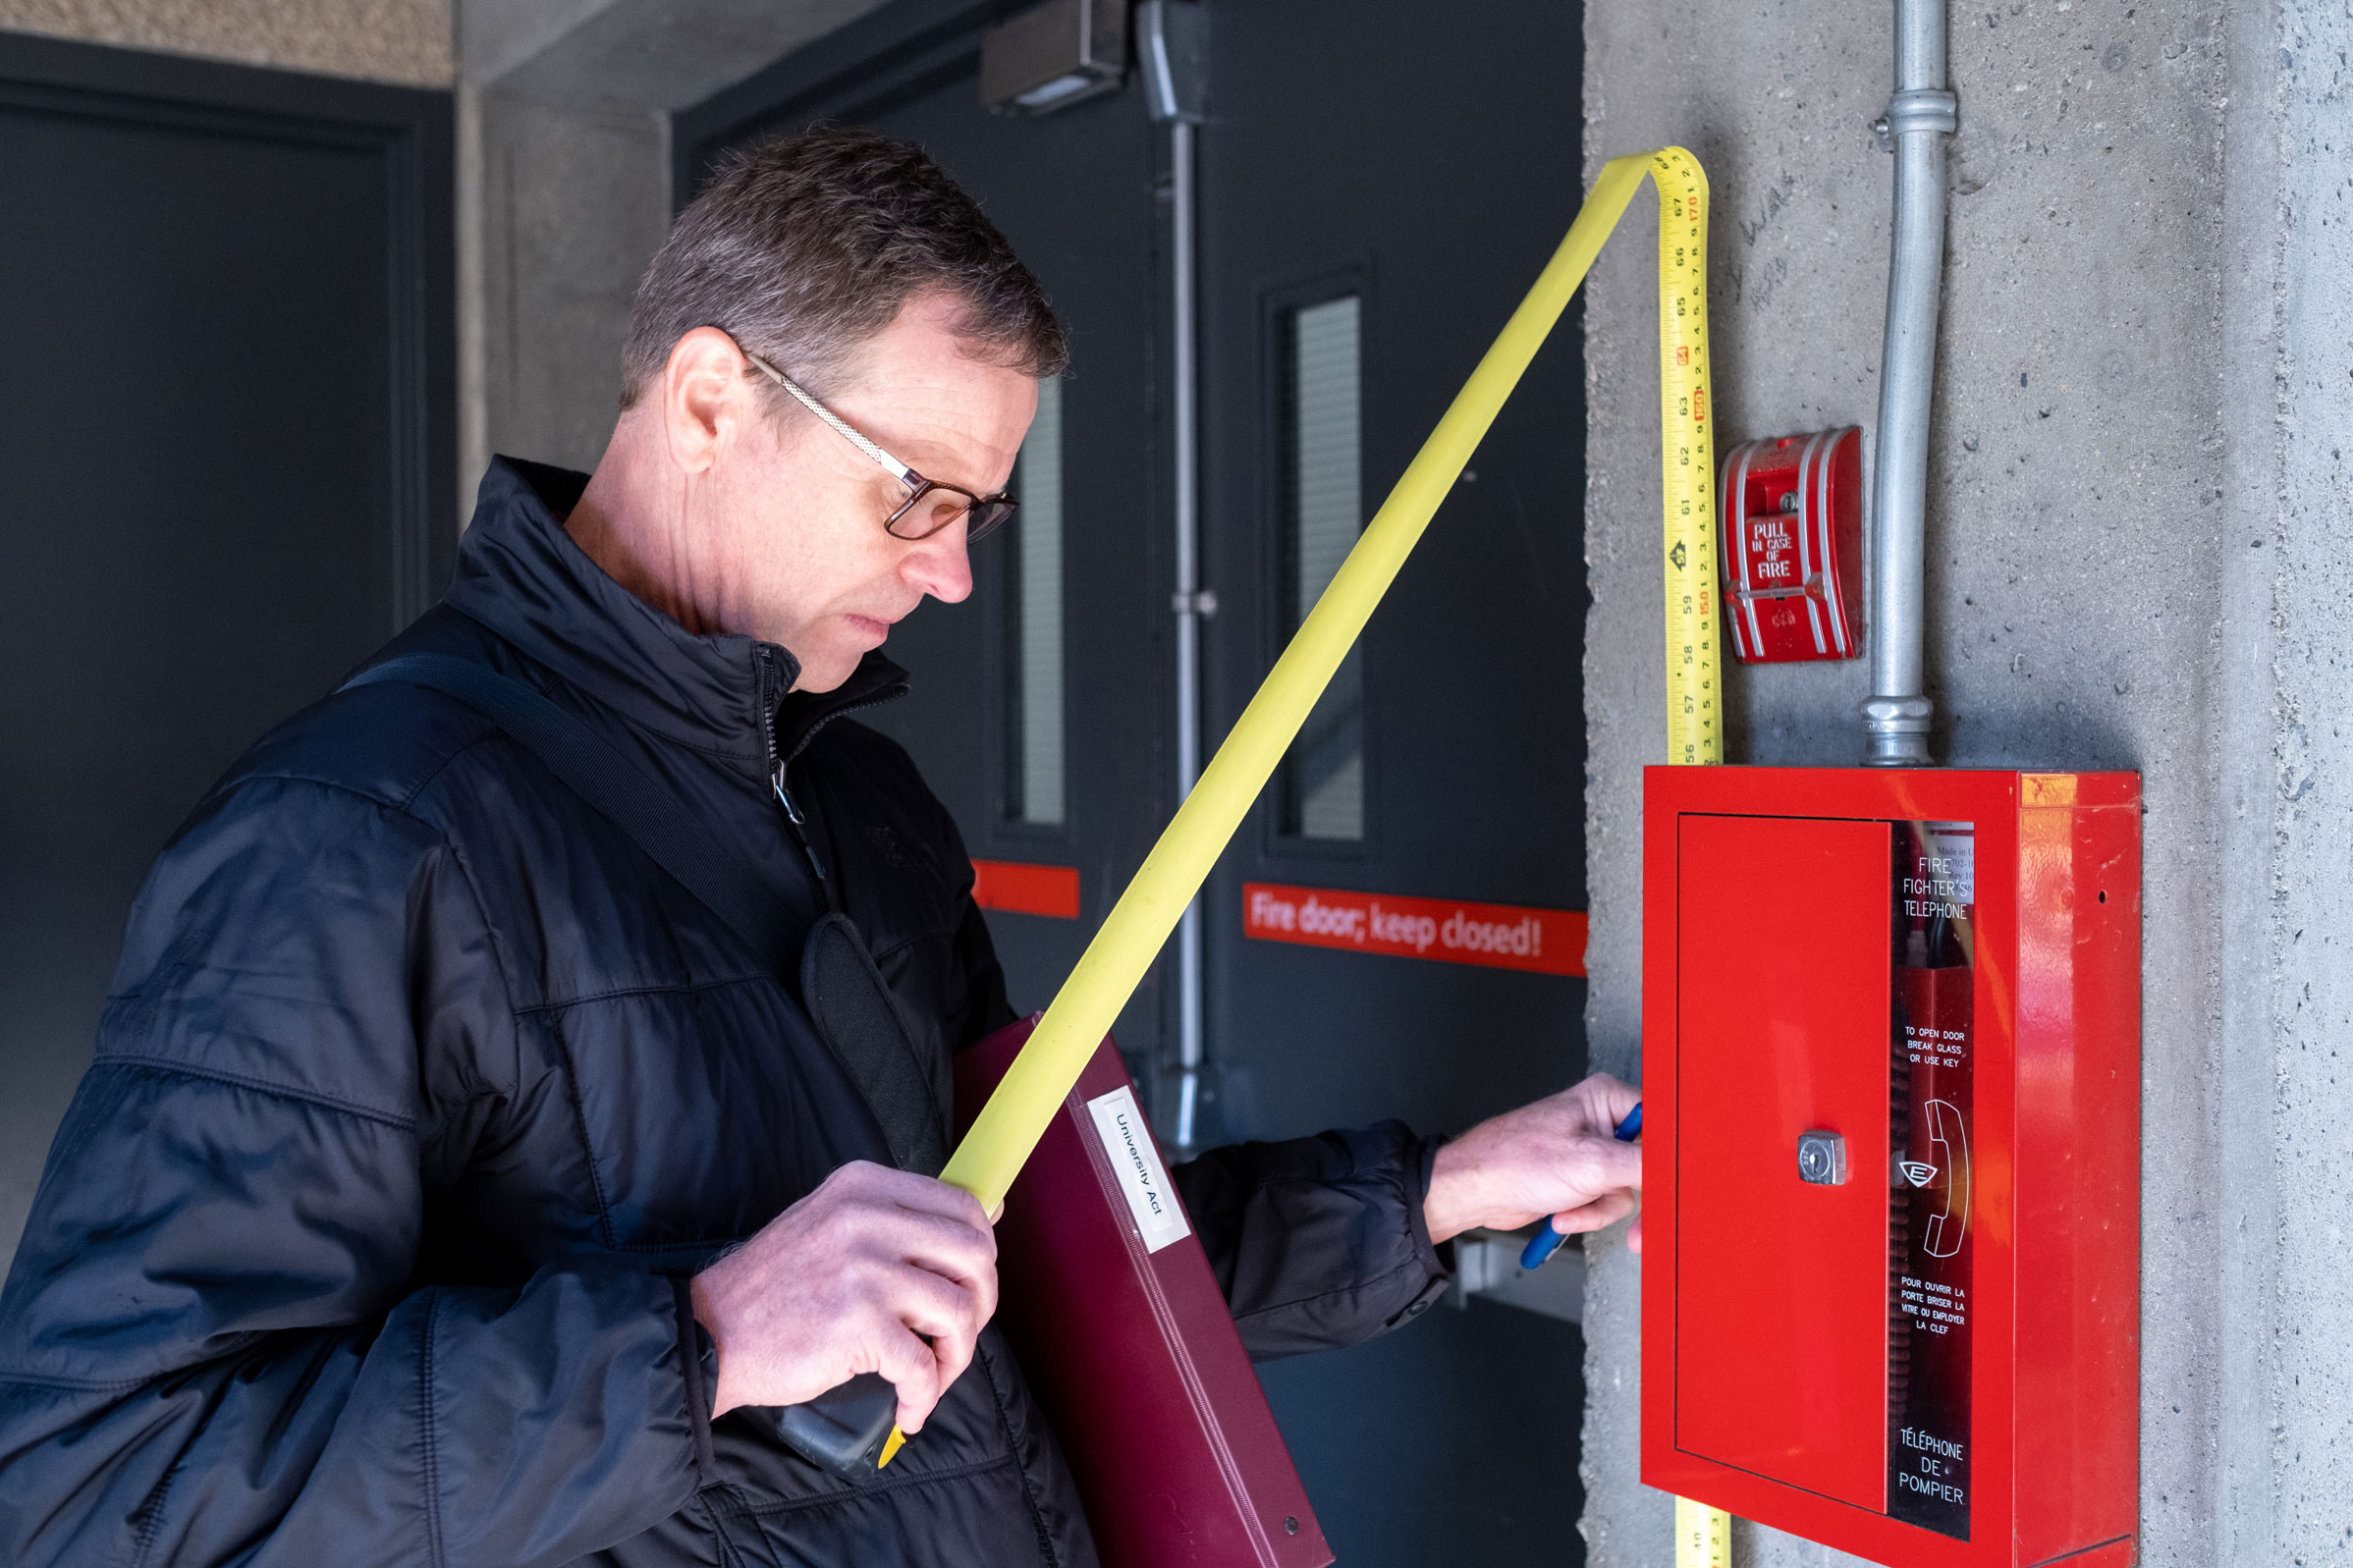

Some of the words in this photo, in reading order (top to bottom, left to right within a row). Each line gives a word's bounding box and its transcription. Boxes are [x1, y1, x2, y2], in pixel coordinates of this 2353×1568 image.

[1673, 198, 1682, 216] 67
[1688, 196, 1698, 222] 170
[1675, 247, 1684, 267] 66
[1677, 297, 1685, 316] 65
[1679, 397, 1688, 416] 63
[1681, 447, 1689, 465] 62
[1681, 500, 1689, 514] 61
[1754, 521, 1787, 540] PULL
[1752, 540, 1763, 552] IN
[1767, 537, 1792, 550] CASE
[1766, 550, 1779, 562] OF
[1701, 563, 1707, 571] 2
[1758, 560, 1790, 579] FIRE
[1683, 596, 1691, 615] 59
[1700, 591, 1709, 615] 150
[1702, 622, 1709, 630] 9
[1684, 645, 1693, 664] 58
[1703, 661, 1710, 670] 7
[1703, 680, 1710, 689] 6
[1685, 695, 1693, 713] 57
[1703, 700, 1711, 709] 5
[1685, 744, 1695, 763] 56
[1937, 846, 1956, 855] Made
[1919, 857, 1951, 874] FIRE
[1903, 878, 1968, 897] FIGHTER'S
[1904, 899, 1967, 919] TELEPHONE
[1250, 891, 1296, 932] Fire
[1298, 894, 1365, 945] door,
[1369, 901, 1437, 953] keep
[1441, 909, 1542, 957] closed!
[1905, 1026, 1915, 1035] TO
[1919, 1028, 1939, 1038] OPEN
[1943, 1031, 1964, 1041] DOOR
[1907, 1040, 1933, 1051] BREAK
[1937, 1044, 1962, 1054] GLASS
[1909, 1054, 1920, 1062] OR
[1925, 1055, 1940, 1065] USE
[1943, 1058, 1959, 1067] KEY
[1117, 1113, 1150, 1186] University
[1147, 1192, 1163, 1216] Act
[1901, 1276, 1921, 1288] POUR
[1925, 1281, 1951, 1295] OUVRIR
[1955, 1288, 1964, 1298] LA
[1901, 1290, 1924, 1302] PORTE
[1927, 1296, 1951, 1309] BRISER
[1955, 1302, 1964, 1312] LA
[1901, 1304, 1918, 1315] VITRE
[1921, 1309, 1930, 1318] OU
[1933, 1311, 1964, 1325] EMPLOYER
[1916, 1321, 1926, 1329] LA
[1930, 1324, 1948, 1334] CLEF
[1901, 1427, 1963, 1461] TÉLÉPHONE
[1921, 1457, 1941, 1477] DE
[1899, 1472, 1963, 1504] POMPIER
